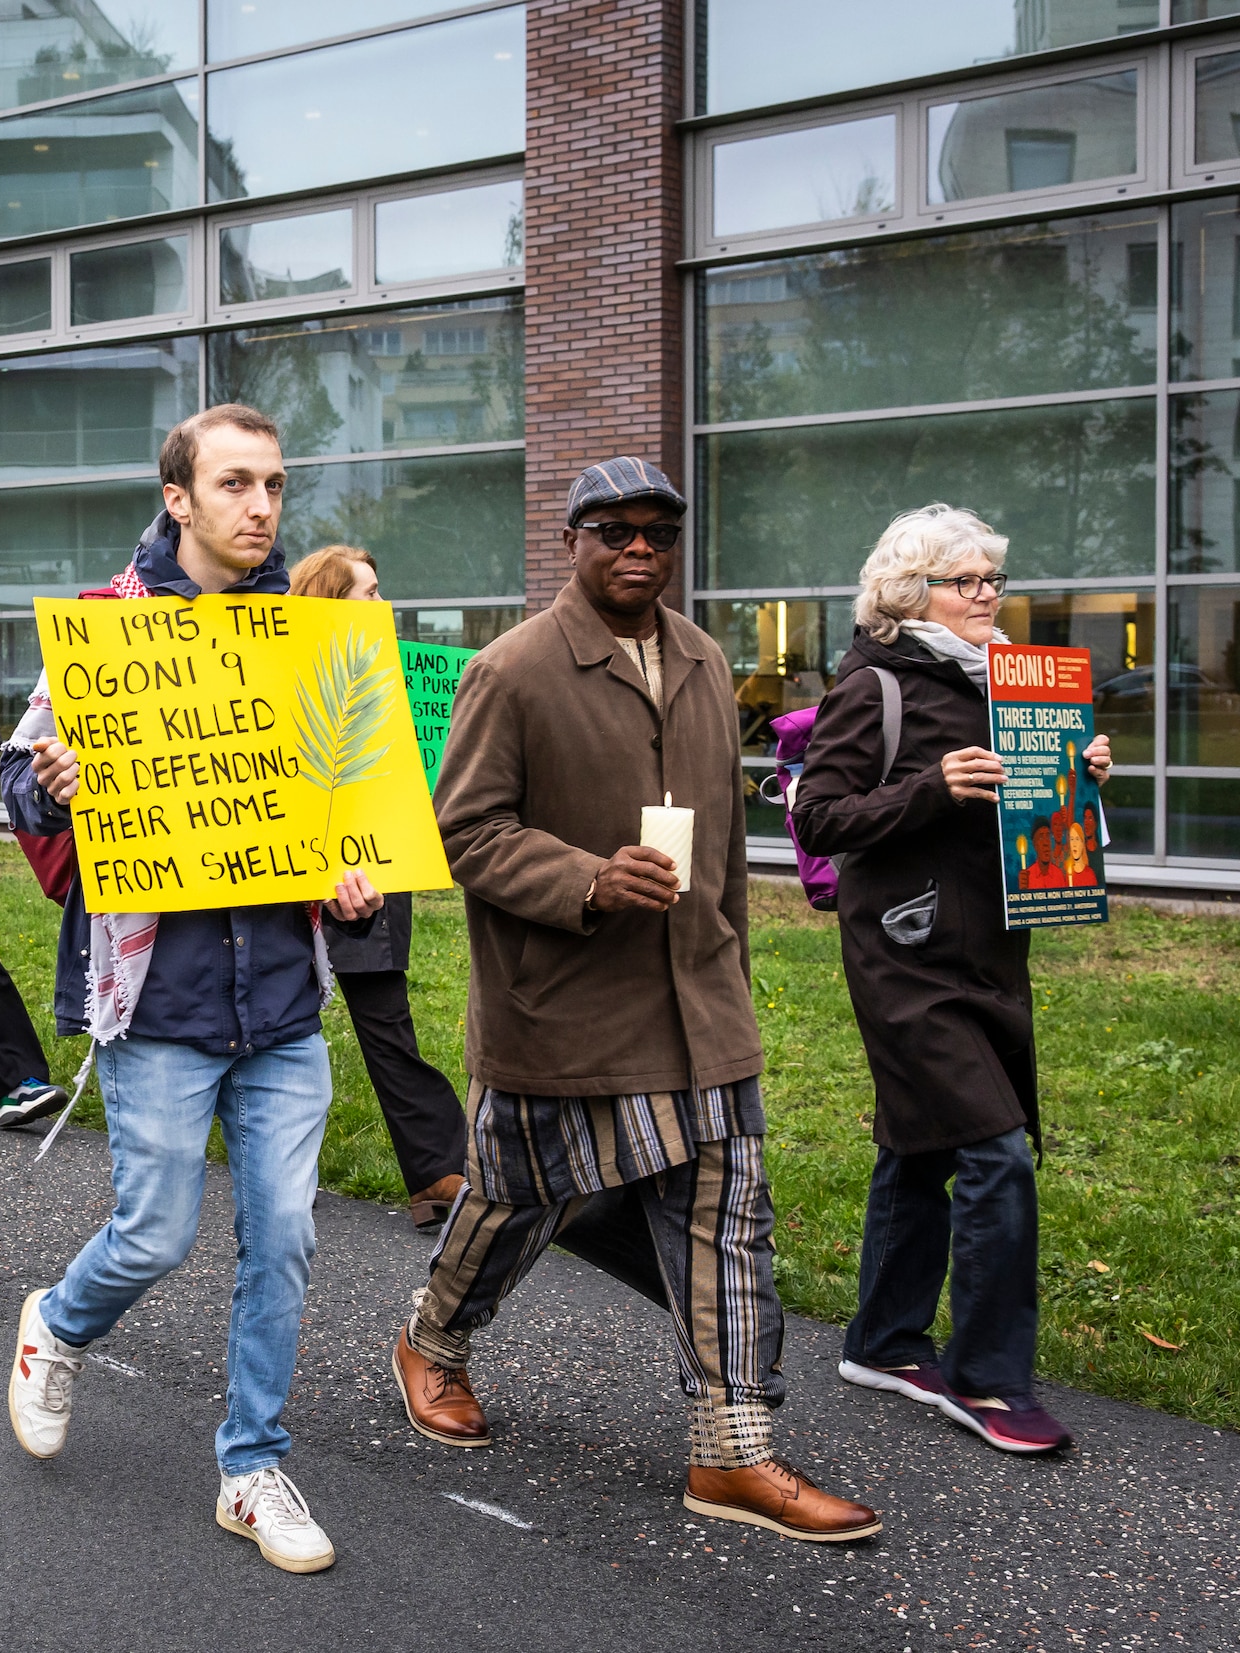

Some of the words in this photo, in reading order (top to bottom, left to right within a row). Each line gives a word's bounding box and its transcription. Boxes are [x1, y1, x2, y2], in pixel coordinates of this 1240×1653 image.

[52, 614, 90, 646] IN
[225, 605, 290, 640] THE
[63, 655, 198, 701] OGONI
[407, 651, 448, 675] LAND
[993, 652, 1044, 687] OGONI
[1044, 655, 1056, 688] 9
[58, 711, 143, 749] WERE
[160, 697, 275, 742] KILLED
[996, 707, 1034, 729] THREE
[1034, 708, 1086, 733] DECADES,
[998, 731, 1016, 752] NO
[1018, 731, 1062, 753] JUSTICE
[76, 761, 121, 796] OR
[131, 745, 302, 792] DEFENDING
[1043, 767, 1057, 776] WITH
[76, 805, 172, 843] THEIR
[185, 789, 286, 830] HOME
[1004, 800, 1015, 810] THE
[93, 856, 184, 897] FROM
[201, 837, 329, 885] SHELL'S
[340, 833, 393, 866] OIL
